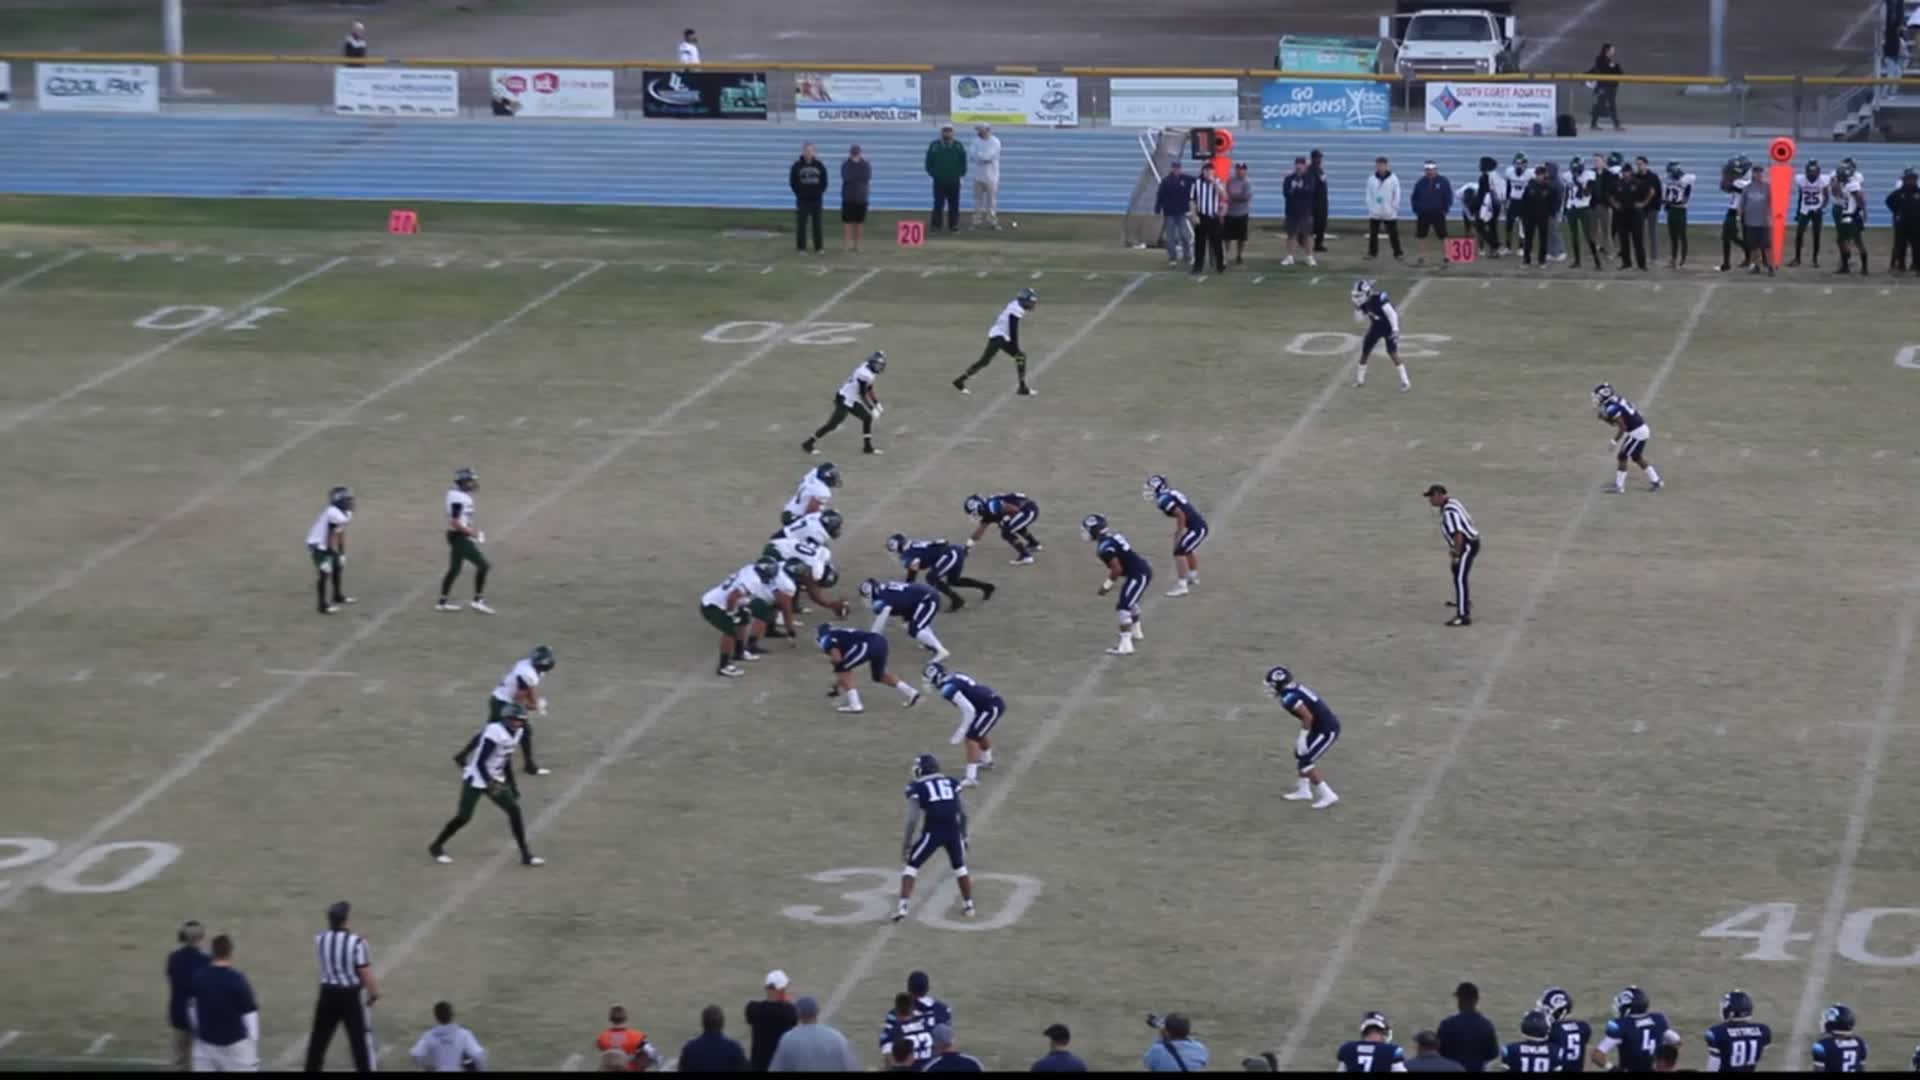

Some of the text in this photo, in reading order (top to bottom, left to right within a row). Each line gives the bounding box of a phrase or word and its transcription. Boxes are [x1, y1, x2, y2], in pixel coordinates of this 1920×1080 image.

[1291, 86, 1314, 101] GO
[1455, 87, 1482, 97] SOUTH
[1484, 87, 1511, 97] COAST
[1263, 98, 1347, 119] SCORPIONS!
[1803, 190, 1821, 205] 25
[901, 224, 921, 244] 20
[1452, 241, 1472, 261] 30
[925, 779, 954, 802] 16
[782, 867, 1042, 931] 30
[1566, 1033, 1580, 1060] 5
[1642, 1029, 1656, 1056] 4
[1357, 1055, 1374, 1072] 7
[1730, 1040, 1758, 1067] 81
[1842, 1050, 1857, 1072] 2
